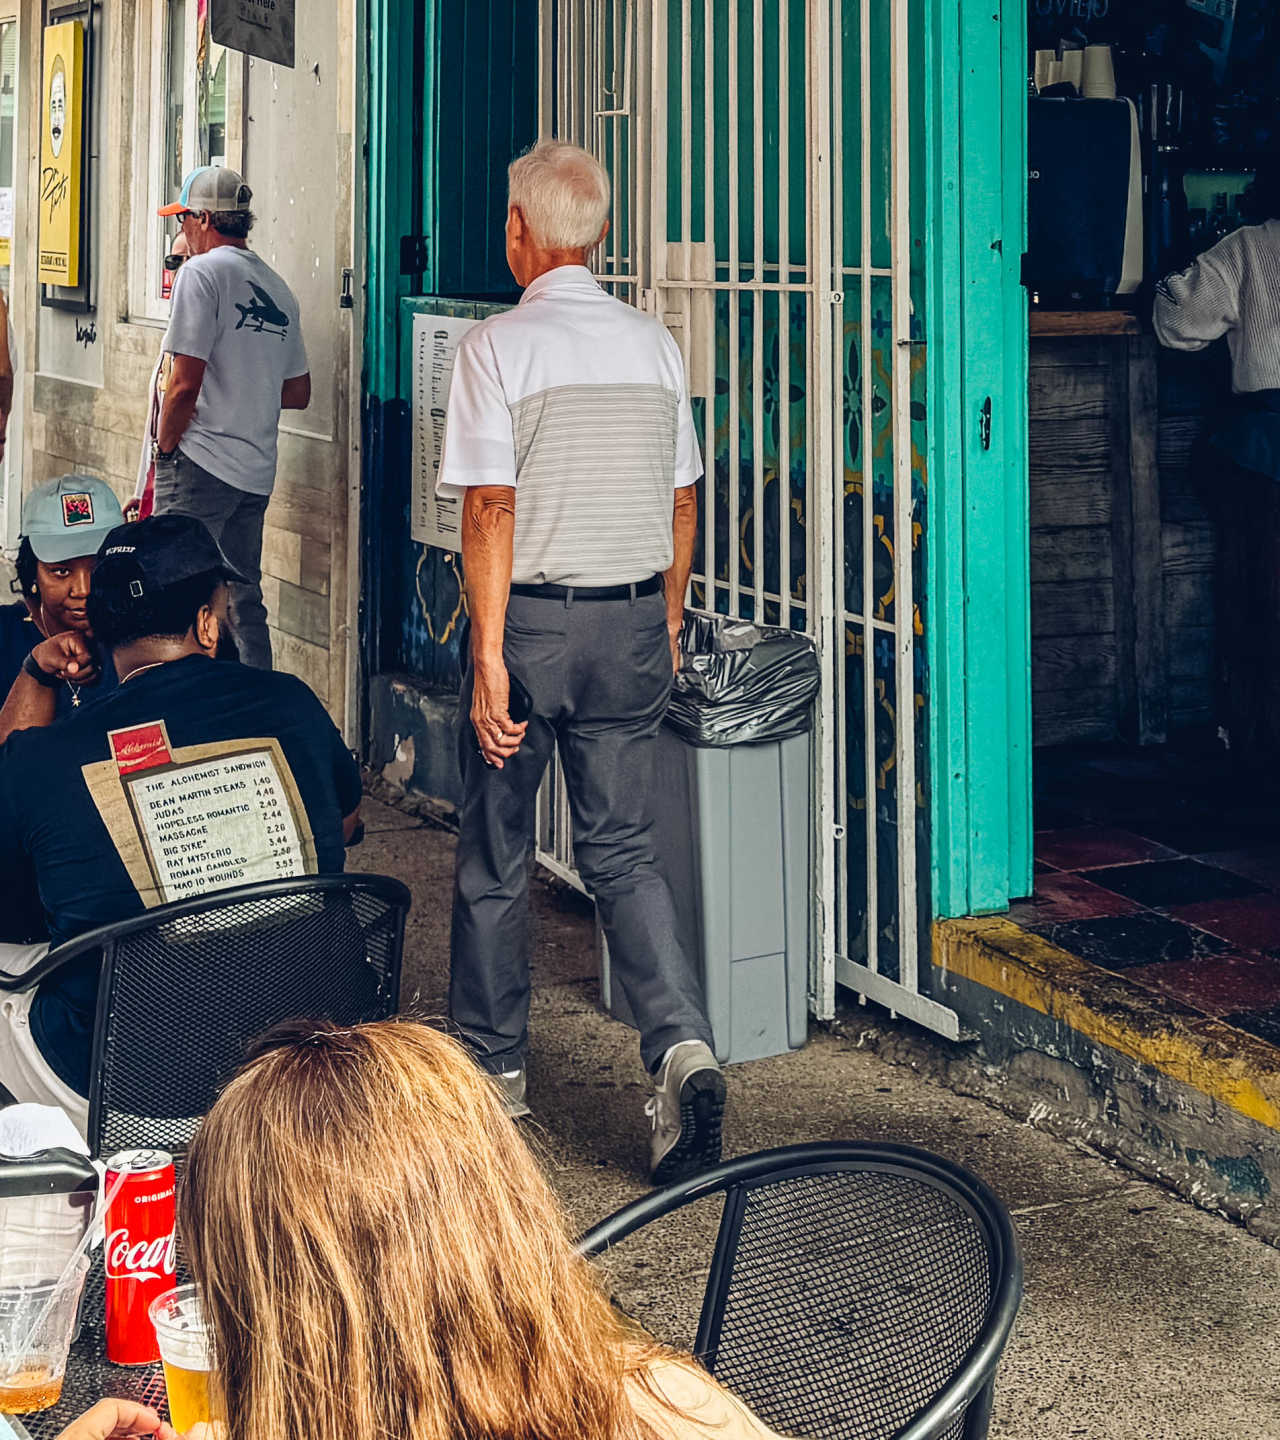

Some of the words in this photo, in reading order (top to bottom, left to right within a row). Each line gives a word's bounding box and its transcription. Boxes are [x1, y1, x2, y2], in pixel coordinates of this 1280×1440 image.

[149, 797, 175, 810] DEAN
[179, 789, 211, 802] MARTIN
[154, 807, 184, 820] JUDAS
[207, 804, 250, 819] ROMANTIC
